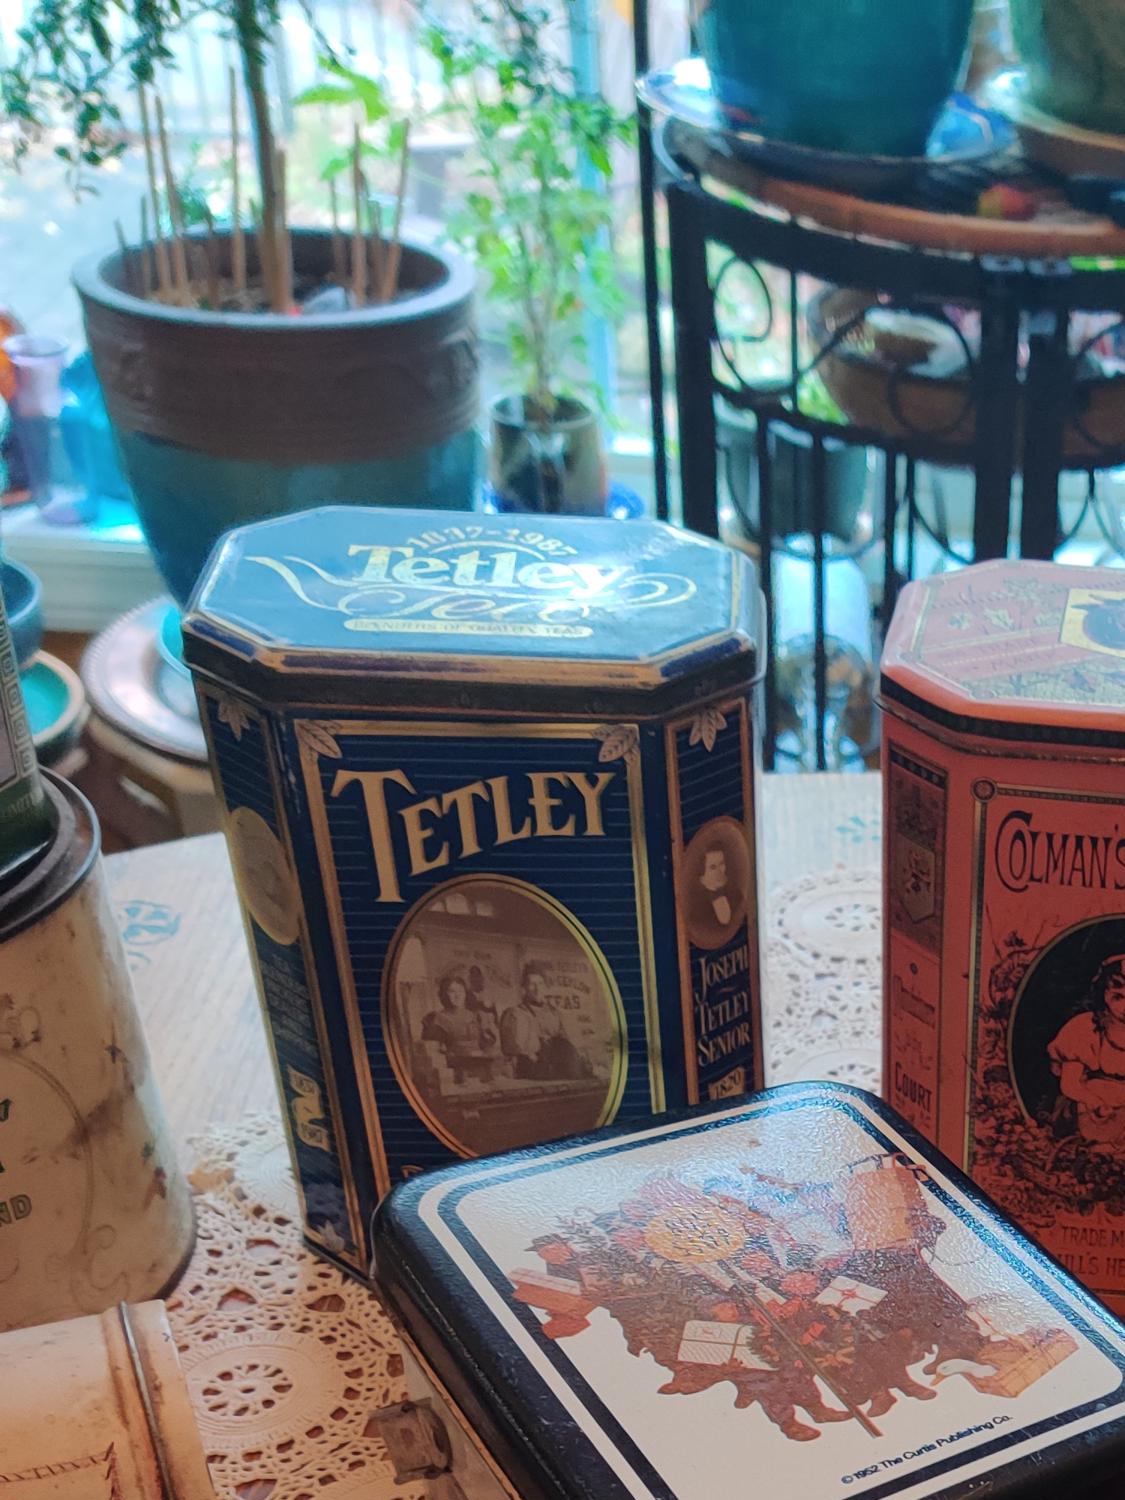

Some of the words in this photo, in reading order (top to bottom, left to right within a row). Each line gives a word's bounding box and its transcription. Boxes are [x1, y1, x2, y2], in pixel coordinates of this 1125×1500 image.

[348, 544, 629, 598] Tetley
[330, 769, 616, 903] TETLEY
[695, 944, 750, 1007] JOSEPH
[696, 991, 750, 1036] TETLEY
[697, 1022, 751, 1067] SENIOR
[894, 1062, 933, 1114] COURT
[1061, 1226, 1107, 1248] TRADE
[881, 1455, 903, 1470] The
[903, 1443, 937, 1461] Curtis
[936, 1420, 993, 1448] Publishing
